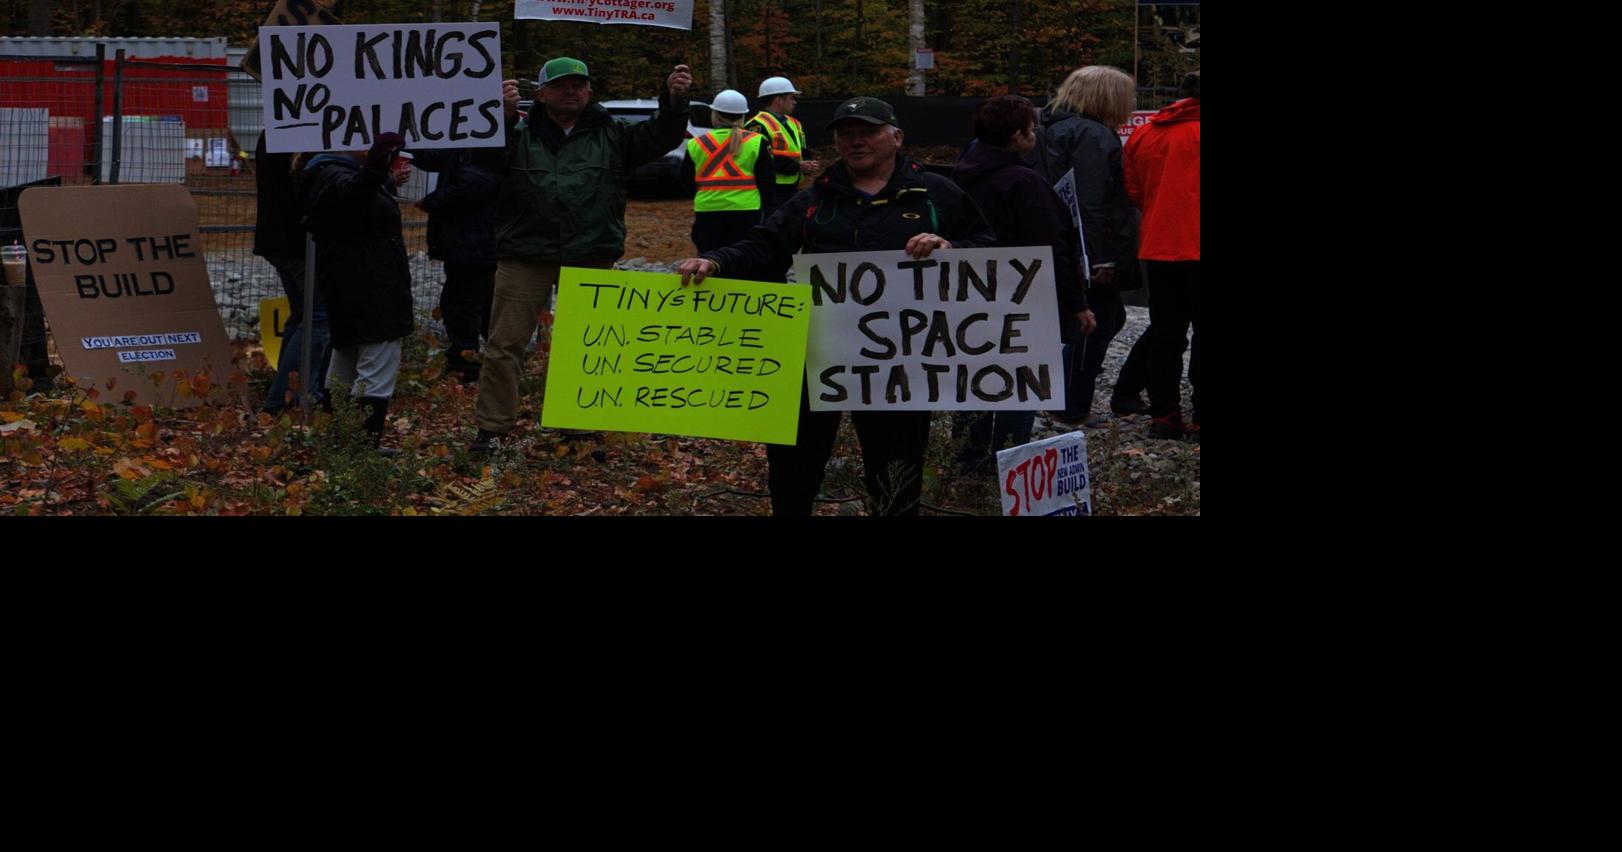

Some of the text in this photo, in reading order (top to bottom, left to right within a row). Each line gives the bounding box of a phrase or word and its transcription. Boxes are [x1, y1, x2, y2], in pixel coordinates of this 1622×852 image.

[552, 7, 656, 20] www.TinyTRA.ca
[270, 29, 497, 80] NO KINGS
[274, 83, 330, 120] NO
[32, 234, 195, 265] STOP THE
[74, 271, 175, 299] BUILD
[810, 259, 1042, 306] NO TINY
[692, 290, 804, 318] FUTURE:
[83, 333, 198, 347] YOU ARE OUT NEXT
[583, 325, 763, 348] U.N. STABLE
[858, 309, 1030, 360] SPACE
[121, 350, 174, 361] ELECTION
[582, 353, 781, 376] U.N. SECURED
[819, 364, 1052, 404] STATION
[577, 387, 769, 410] U.N. RESCUED
[1061, 445, 1078, 464] THE
[1006, 448, 1058, 516] STOP
[1057, 474, 1086, 497] BUILD
